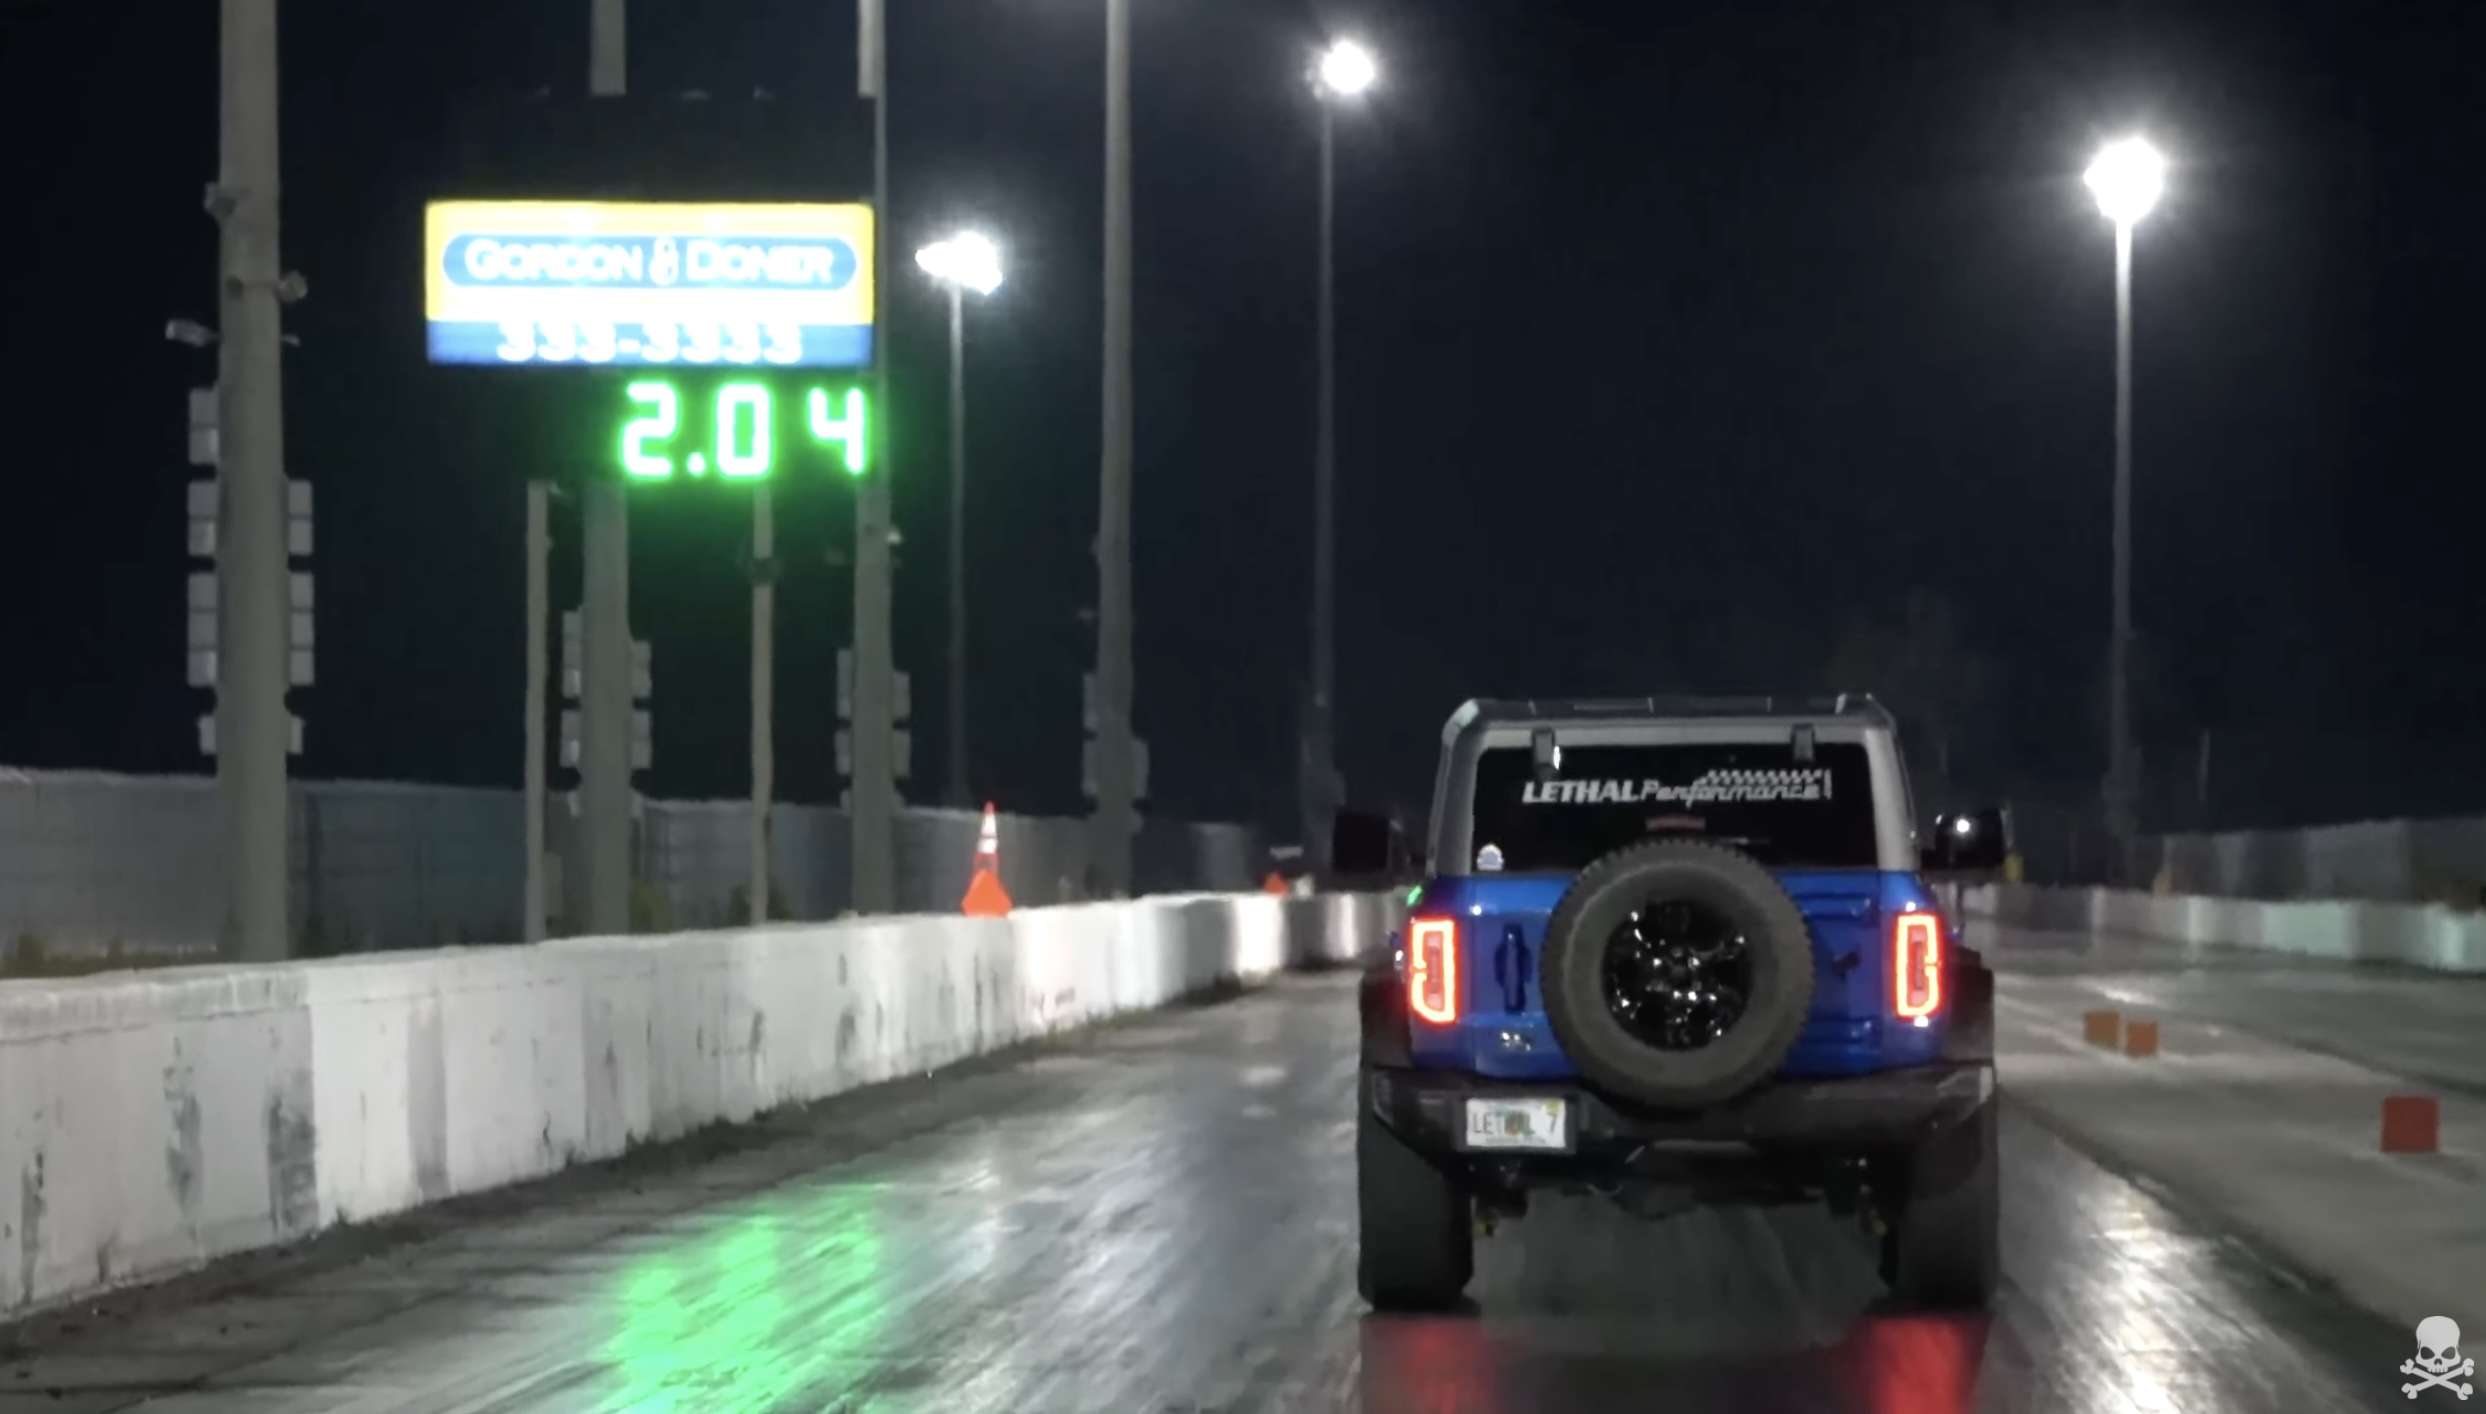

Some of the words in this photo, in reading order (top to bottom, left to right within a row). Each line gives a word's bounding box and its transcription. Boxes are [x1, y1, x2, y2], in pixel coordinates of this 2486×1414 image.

[465, 239, 643, 279] GORDON
[687, 239, 833, 283] DONER
[1522, 780, 1640, 803] LETHAL
[1640, 779, 1820, 808] Performance
